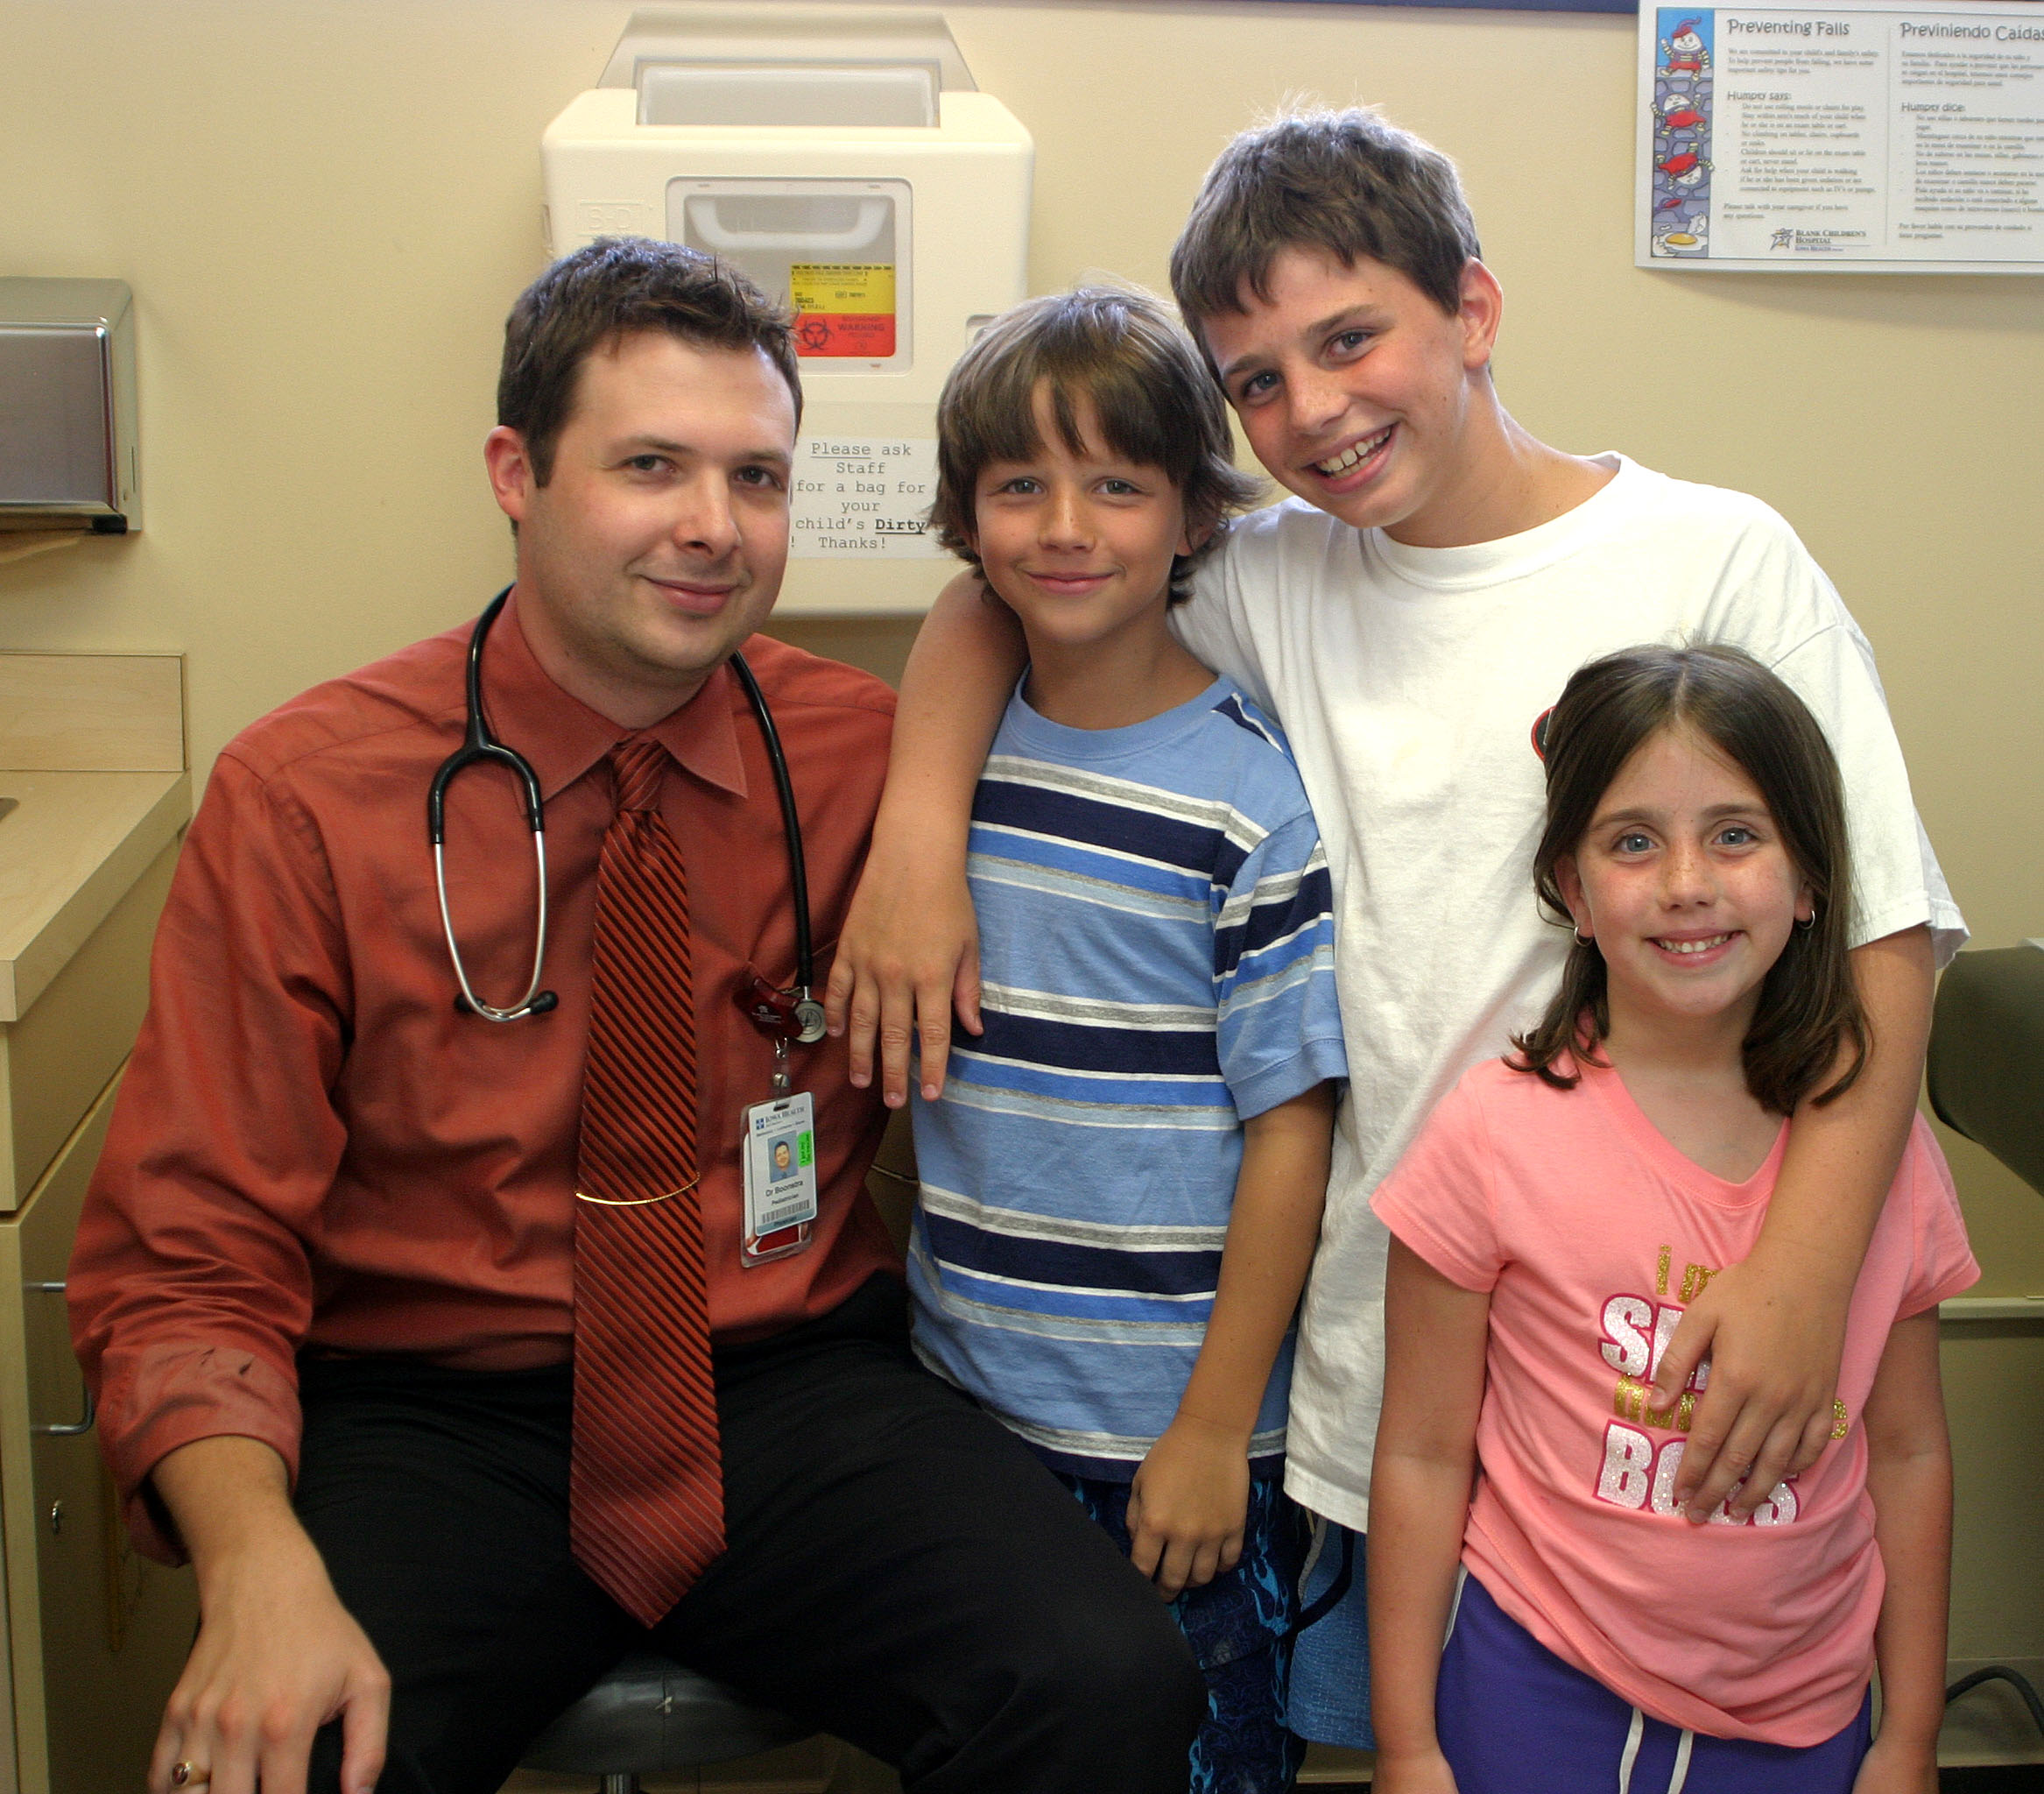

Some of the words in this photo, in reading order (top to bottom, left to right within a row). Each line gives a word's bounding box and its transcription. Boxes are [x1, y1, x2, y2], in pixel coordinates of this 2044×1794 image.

[1727, 18, 1812, 36] Preventing
[1815, 21, 1850, 35] Falls
[1900, 22, 1991, 38] Previniendo
[1901, 102, 1940, 112] Humpty
[811, 442, 871, 456] Please
[882, 443, 912, 456] ask
[836, 463, 886, 474] Staff
[796, 480, 825, 492] for
[836, 483, 845, 492] a
[856, 481, 885, 495] bag
[898, 482, 926, 493] for
[842, 501, 880, 513] your
[795, 518, 865, 530] child's
[875, 519, 927, 533] Dirty
[819, 537, 886, 549] Thanks!
[765, 1189, 774, 1197] Dr
